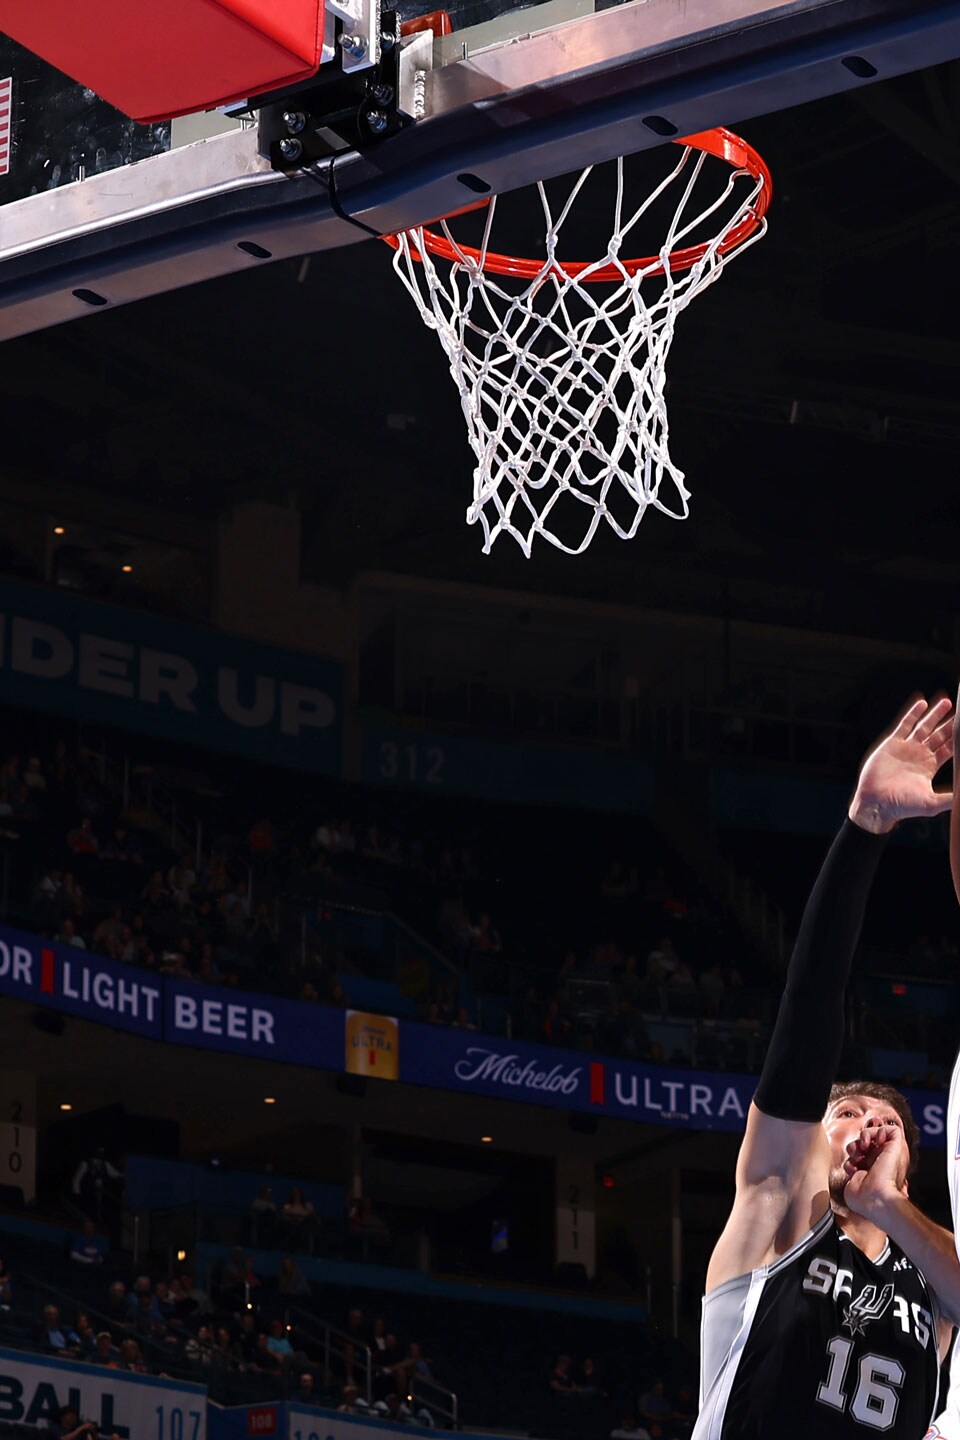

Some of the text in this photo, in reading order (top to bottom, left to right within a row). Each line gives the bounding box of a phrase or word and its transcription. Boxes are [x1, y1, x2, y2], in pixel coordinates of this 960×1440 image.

[217, 665, 336, 736] UP
[379, 740, 446, 784] 312
[62, 961, 160, 1022] LIGHT
[174, 995, 275, 1045] BEER
[454, 1048, 744, 1119] Michelob ULTRA
[815, 1335, 907, 1432] 16
